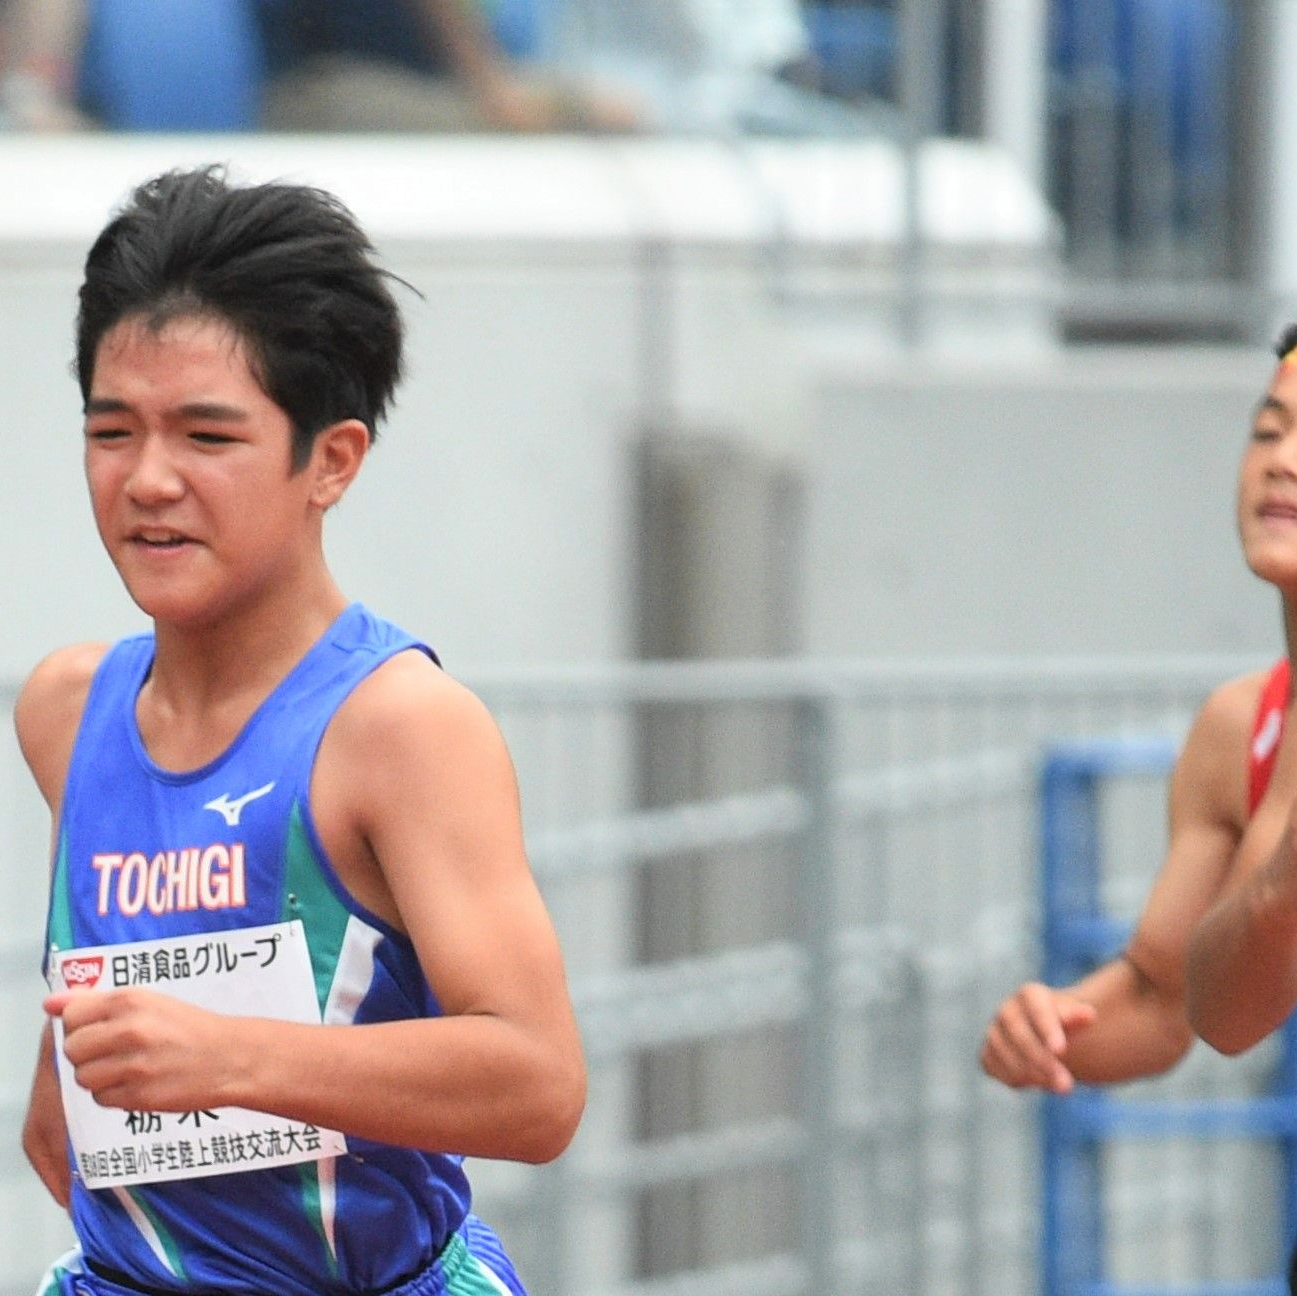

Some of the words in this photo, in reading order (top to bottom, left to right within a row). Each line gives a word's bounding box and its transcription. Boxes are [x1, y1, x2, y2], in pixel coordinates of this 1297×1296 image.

[91, 843, 247, 918] TOCHIGI
[111, 932, 282, 987] 日清食品グループ
